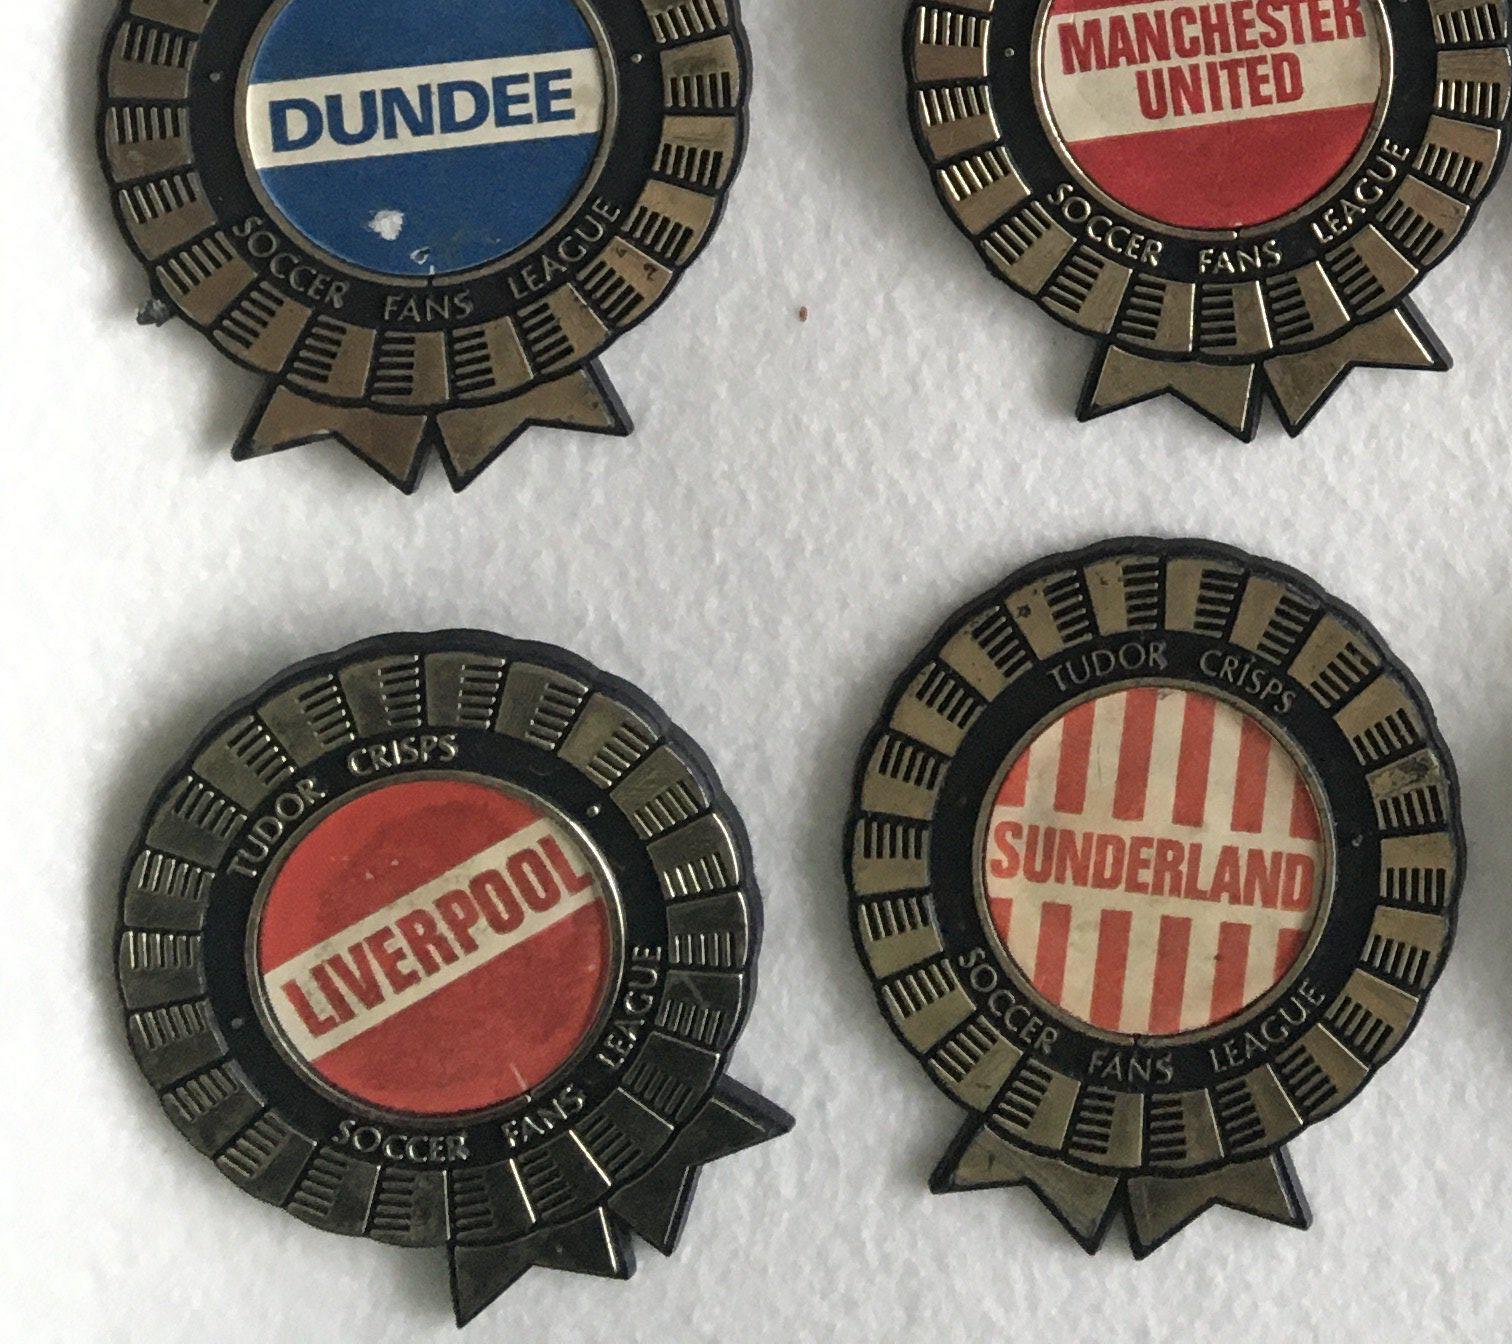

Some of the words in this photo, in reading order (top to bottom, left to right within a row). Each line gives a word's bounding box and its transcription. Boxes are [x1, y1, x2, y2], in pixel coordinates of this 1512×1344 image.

[268, 68, 576, 153] DUNDEE
[1135, 52, 1305, 120] UNITED
[232, 216, 351, 310] SOCCER
[384, 289, 475, 322] FANS
[507, 196, 621, 300] LEAGUE
[1047, 183, 1165, 268] SOCCER
[1198, 239, 1283, 274] FANS
[1310, 138, 1411, 244] LEAGUE
[1046, 641, 1168, 692] TUDOR
[1199, 650, 1297, 715] CRISPS
[226, 778, 327, 879] TUDOR
[346, 733, 460, 777] CRISPS
[990, 820, 1316, 912] SUNDERLAND
[282, 833, 593, 1040] LIVERPOOL
[333, 1120, 471, 1163] SOCCER
[500, 1084, 587, 1149] FANS
[596, 944, 664, 1068] LEAGUE
[959, 947, 1058, 1055] SOCCER
[1088, 1048, 1175, 1084] FANS
[1209, 979, 1326, 1072] LEAGUE
